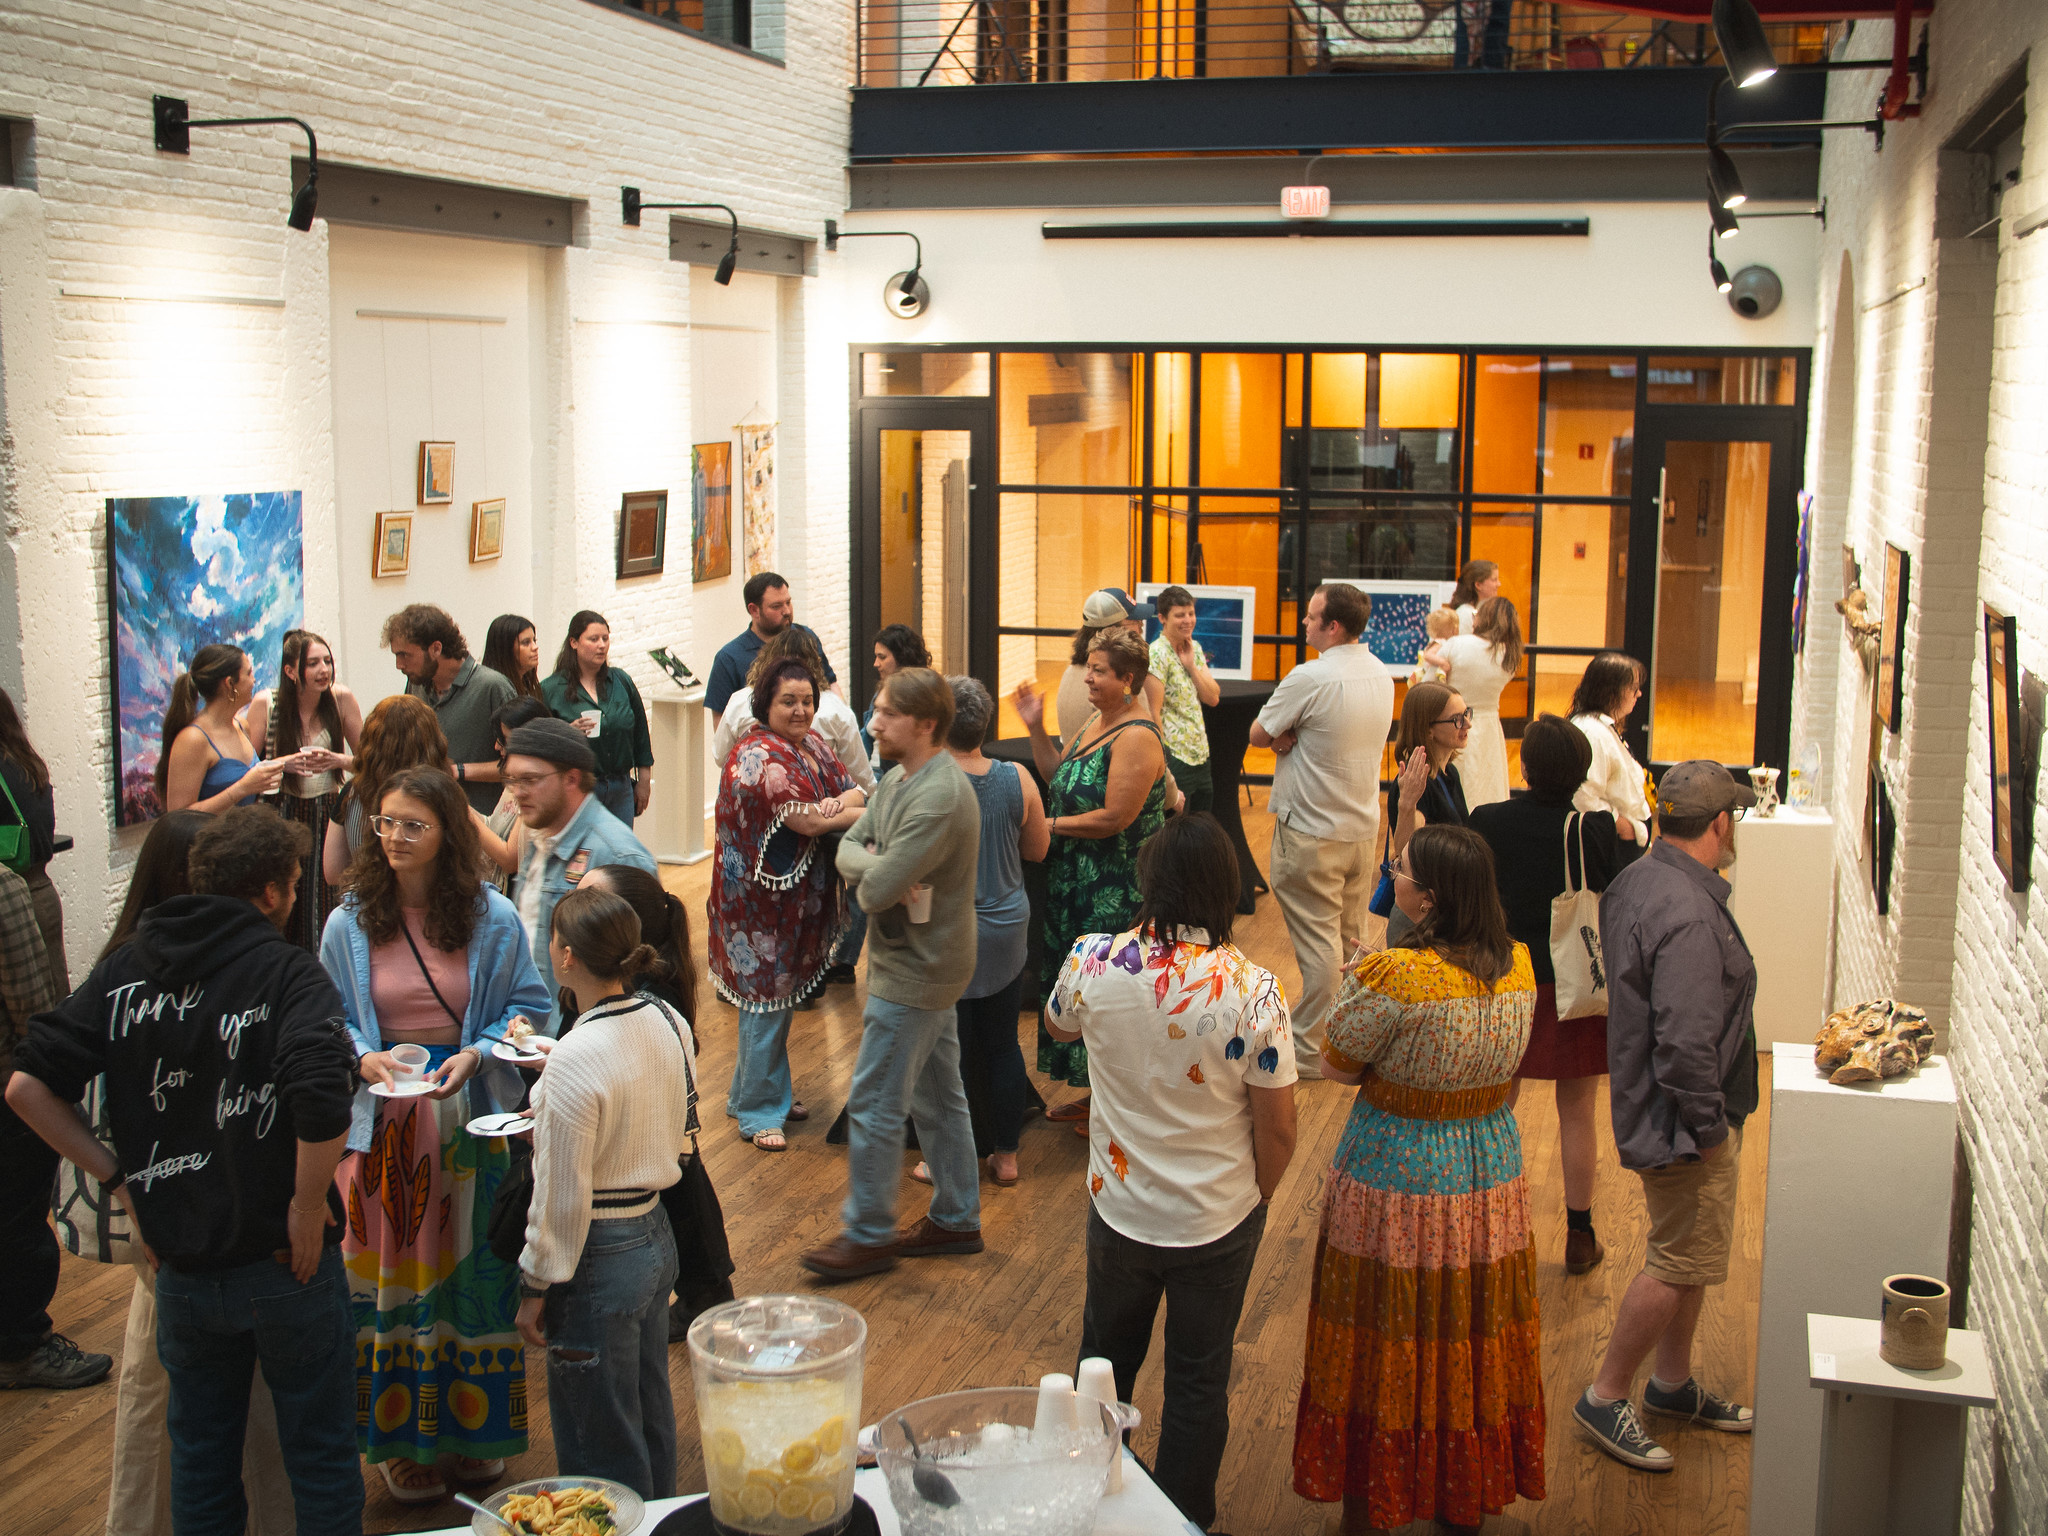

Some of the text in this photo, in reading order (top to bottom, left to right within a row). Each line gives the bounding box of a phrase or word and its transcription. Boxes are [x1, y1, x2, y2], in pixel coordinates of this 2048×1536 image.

[1289, 189, 1322, 215] EXIT
[106, 980, 270, 1060] Thank you
[149, 1057, 277, 1139] for being
